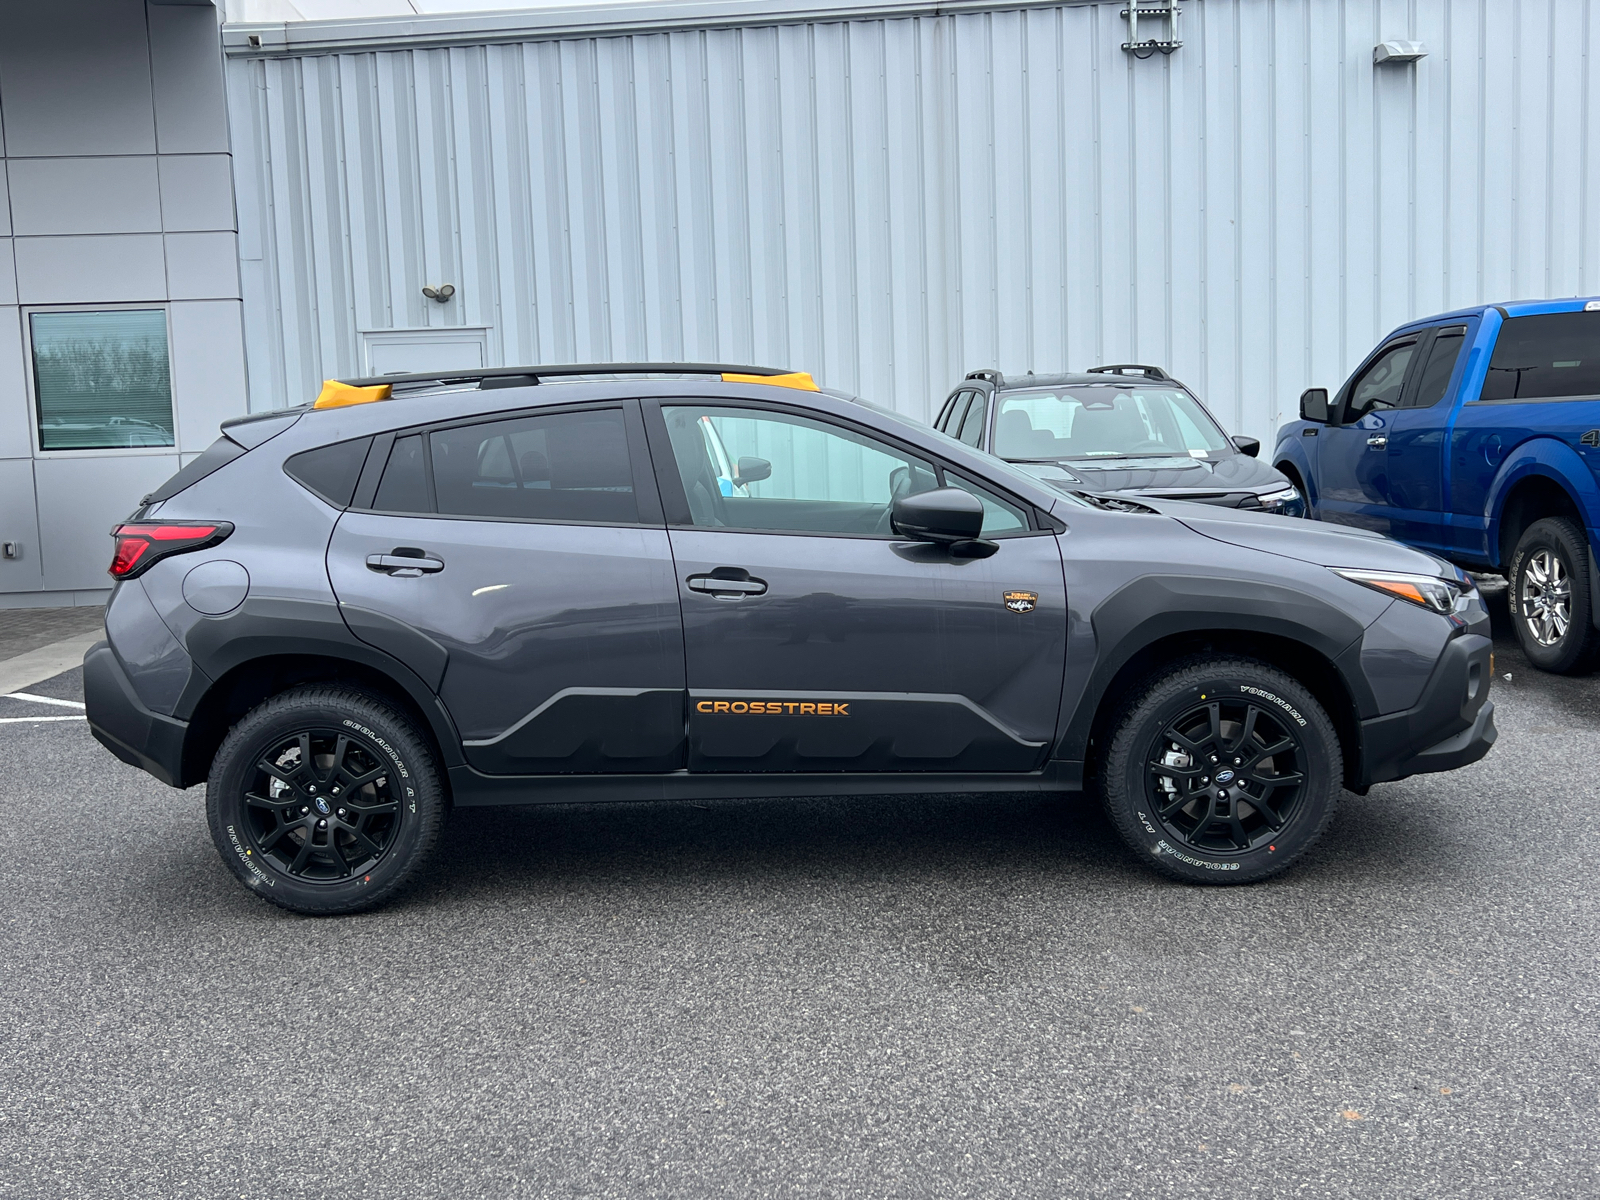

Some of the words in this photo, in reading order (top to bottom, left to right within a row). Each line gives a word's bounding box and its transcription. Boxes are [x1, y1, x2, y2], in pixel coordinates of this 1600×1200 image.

[1580, 428, 1600, 448] 4
[1509, 551, 1525, 614] GENERAL
[696, 701, 849, 716] CROSSTREK
[1240, 685, 1307, 727] YOKOHAMA
[343, 719, 409, 778] GEOLANDAR
[1137, 811, 1156, 833] A/T
[227, 825, 275, 887] YOKOHAMA
[1158, 839, 1240, 871] GEOLANDAR
